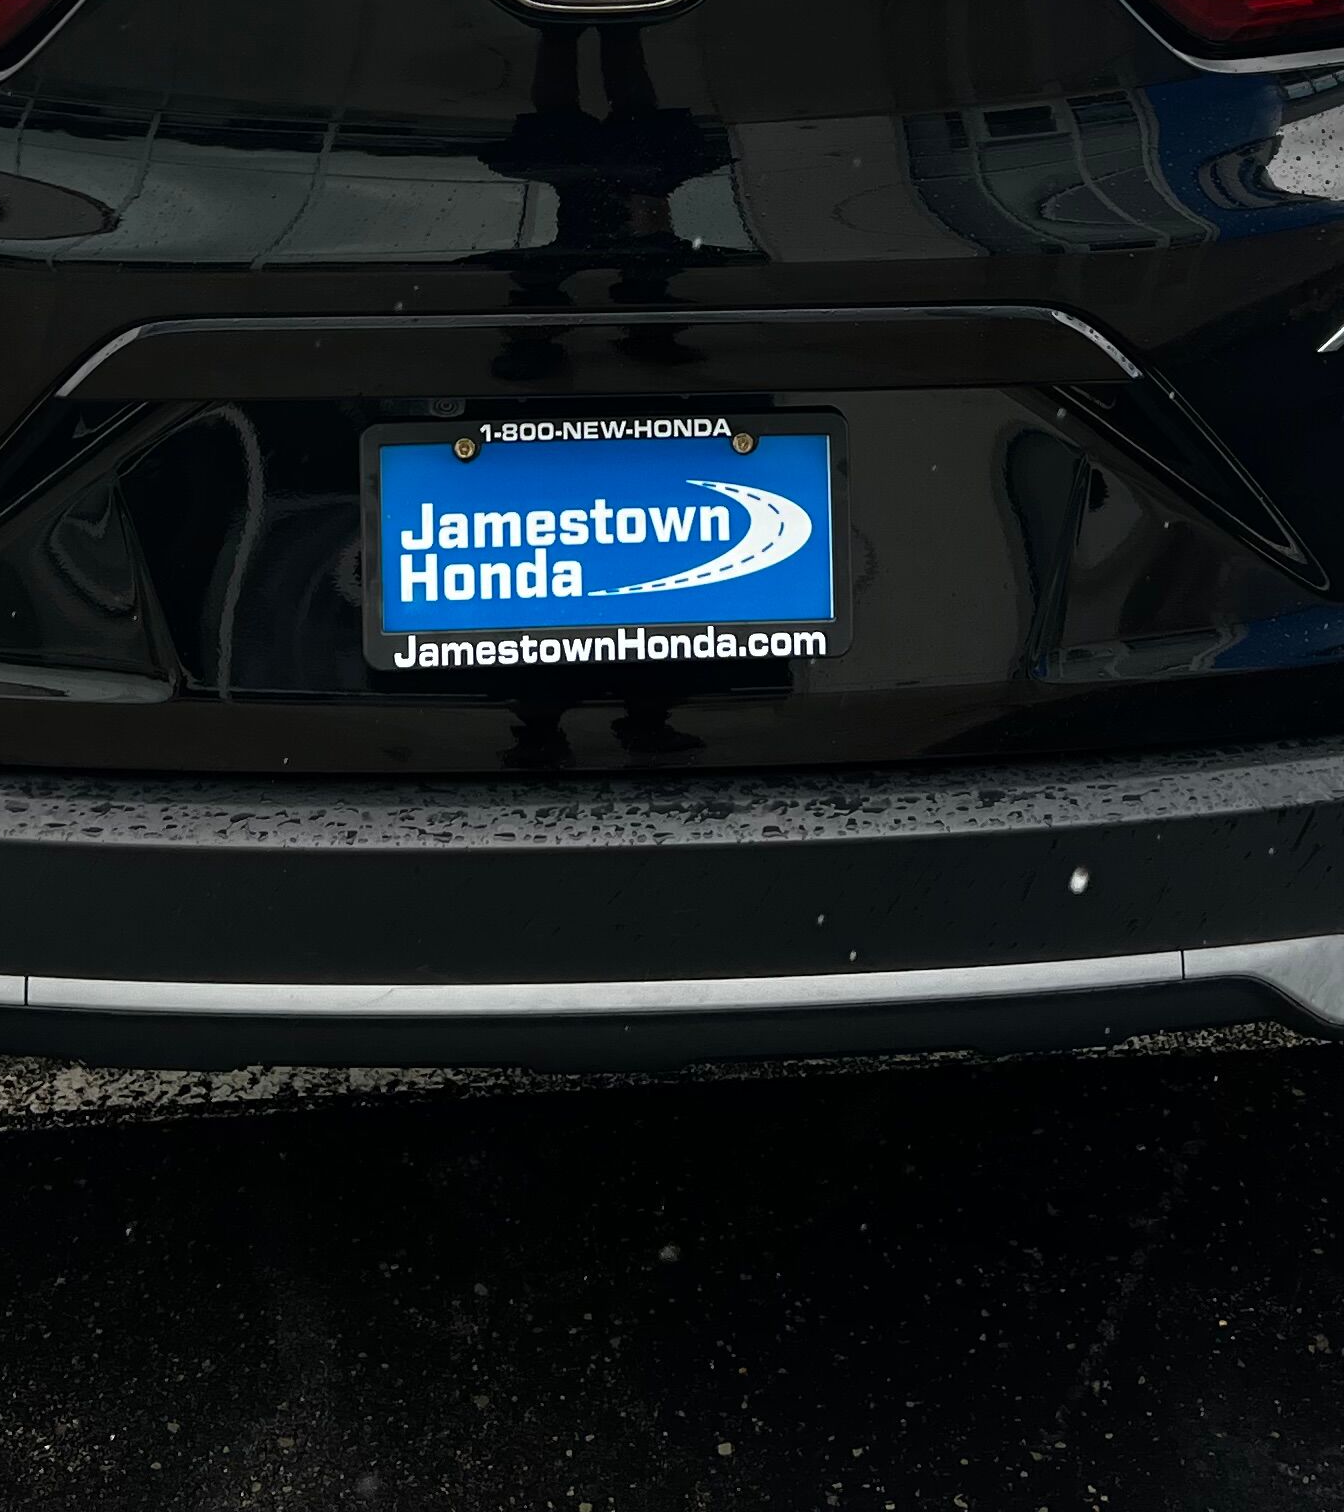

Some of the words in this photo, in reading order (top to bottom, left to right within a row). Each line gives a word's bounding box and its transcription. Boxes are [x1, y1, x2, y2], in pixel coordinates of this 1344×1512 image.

[479, 417, 732, 443] 1-800-NEW-HONDA
[399, 498, 731, 551] Jamestown
[399, 548, 584, 603] Honda
[392, 624, 827, 669] JamestownHonda.com
